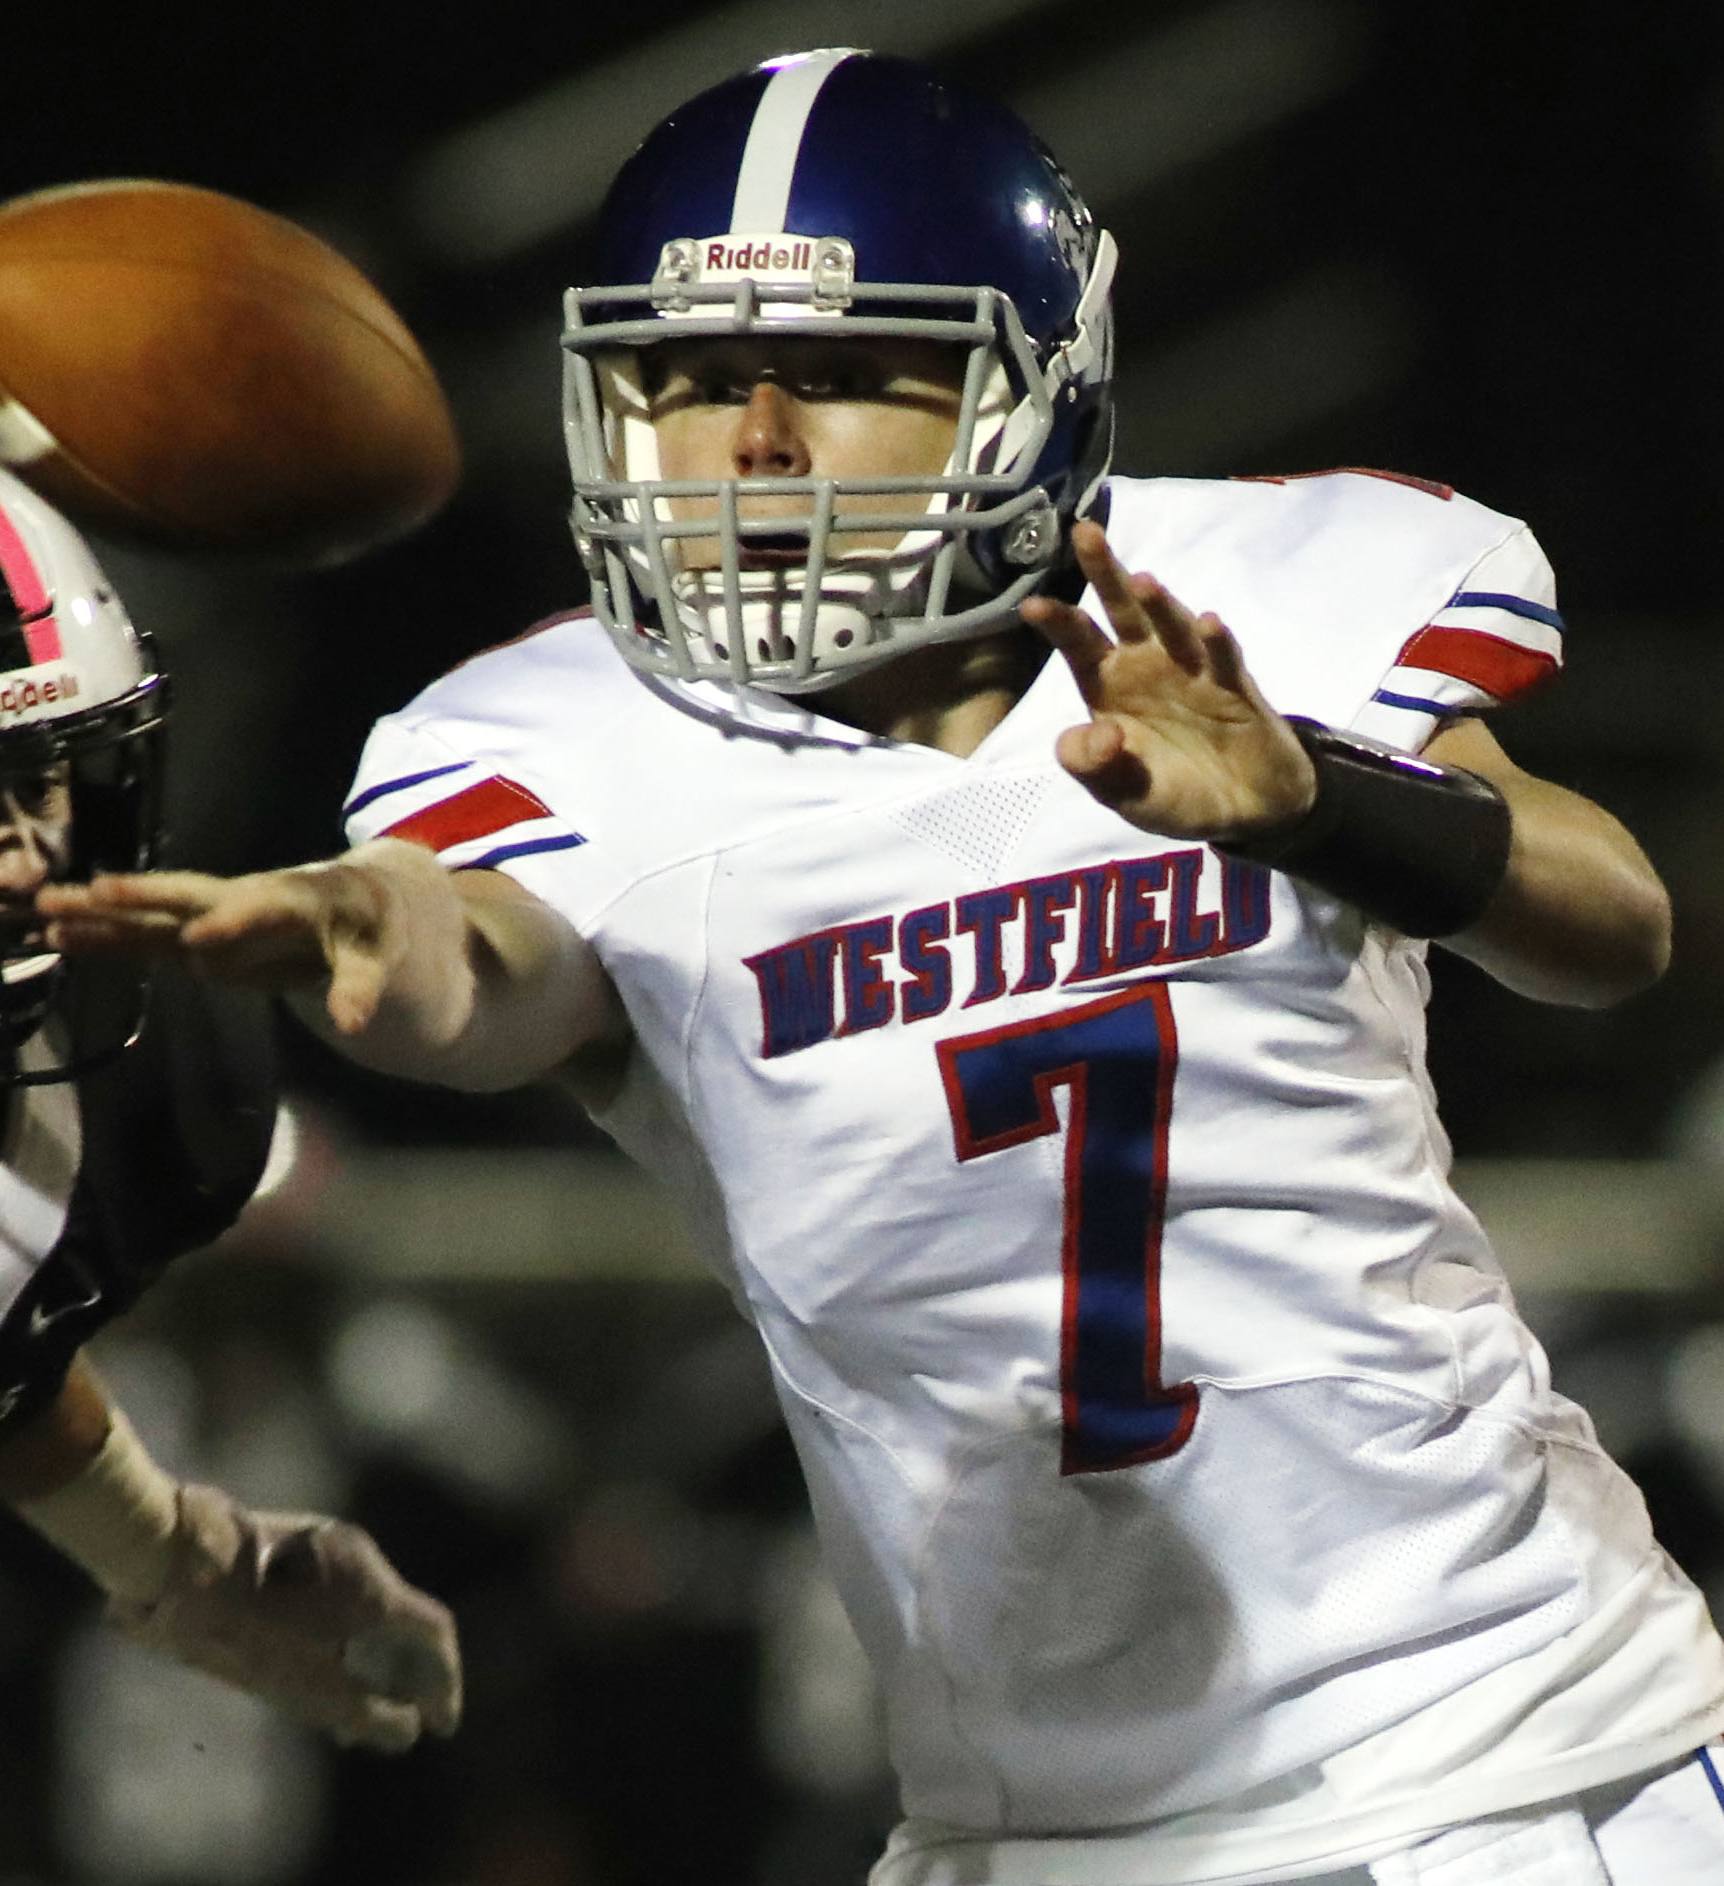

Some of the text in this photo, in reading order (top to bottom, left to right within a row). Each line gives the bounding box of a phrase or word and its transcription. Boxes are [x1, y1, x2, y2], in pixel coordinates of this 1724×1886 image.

[706, 242, 811, 270] Riddell
[742, 841, 1273, 1059] WESTFIELD
[935, 978, 1200, 1476] 7
